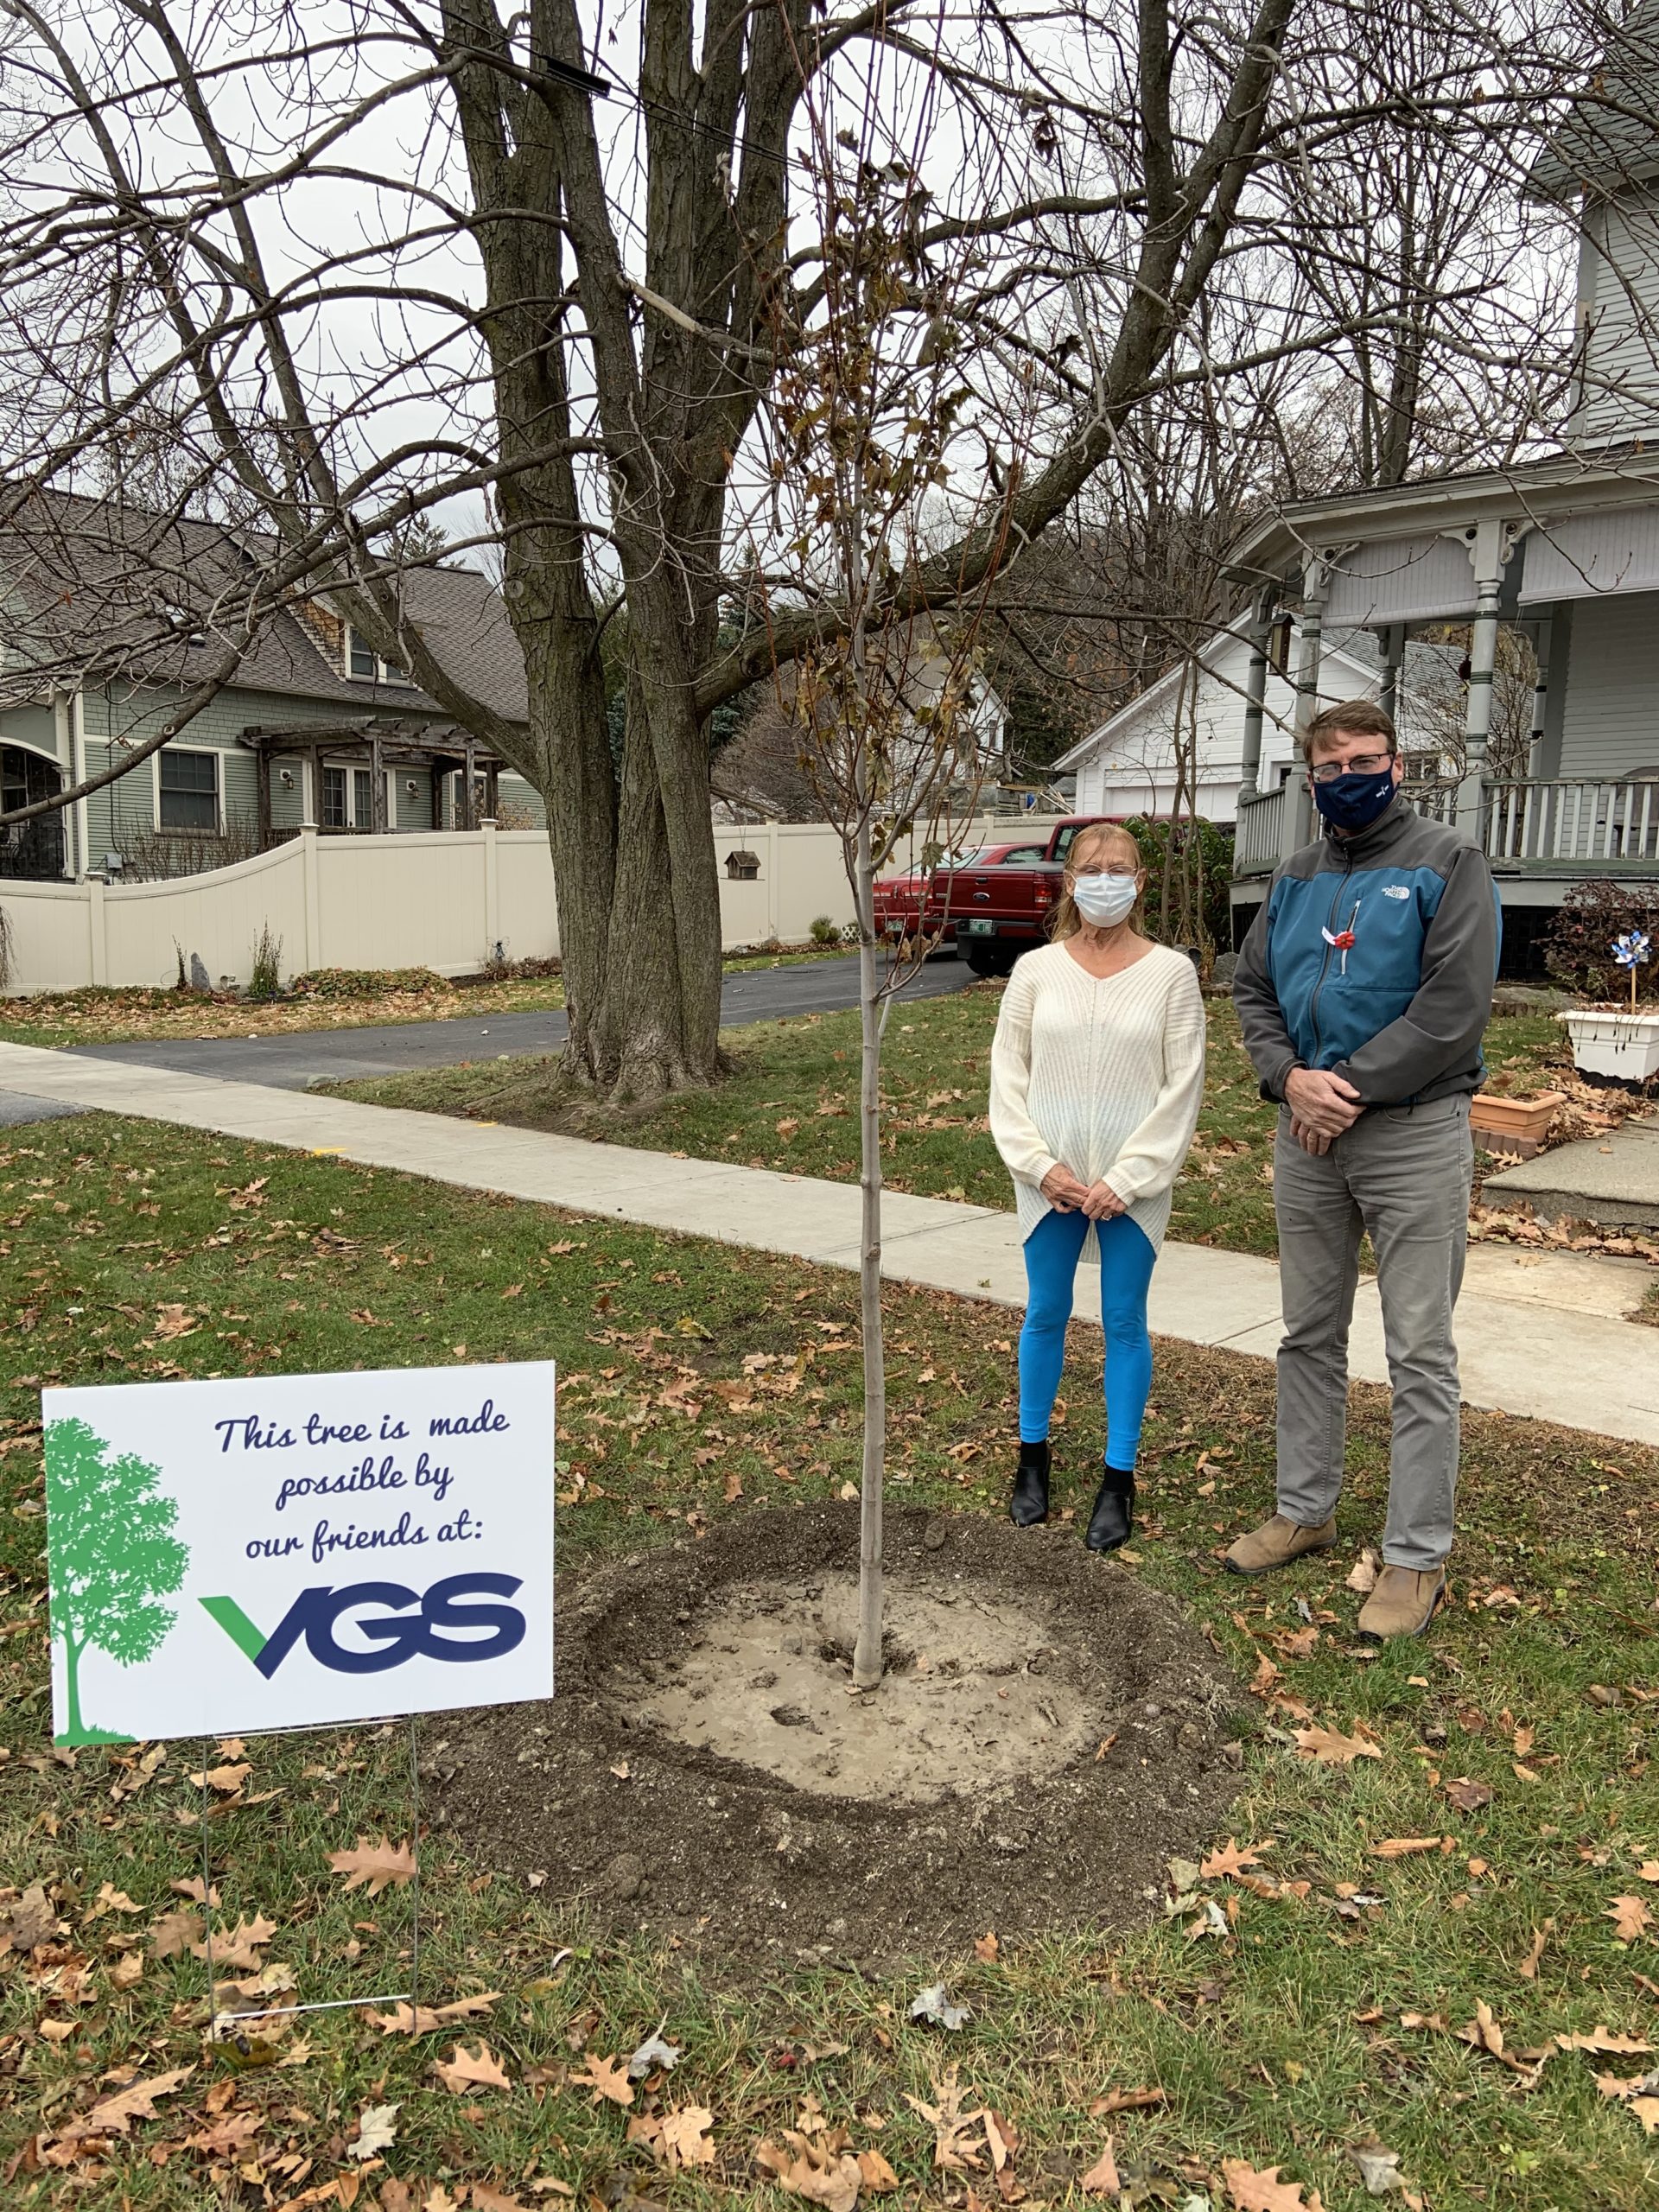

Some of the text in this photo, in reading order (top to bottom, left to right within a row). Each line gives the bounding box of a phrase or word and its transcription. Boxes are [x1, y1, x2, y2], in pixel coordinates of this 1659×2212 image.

[214, 1399, 511, 1452] This tree is made
[275, 1452, 455, 1511] possible by
[245, 1509, 484, 1564] our friends at:
[198, 1572, 527, 1681] VGS
